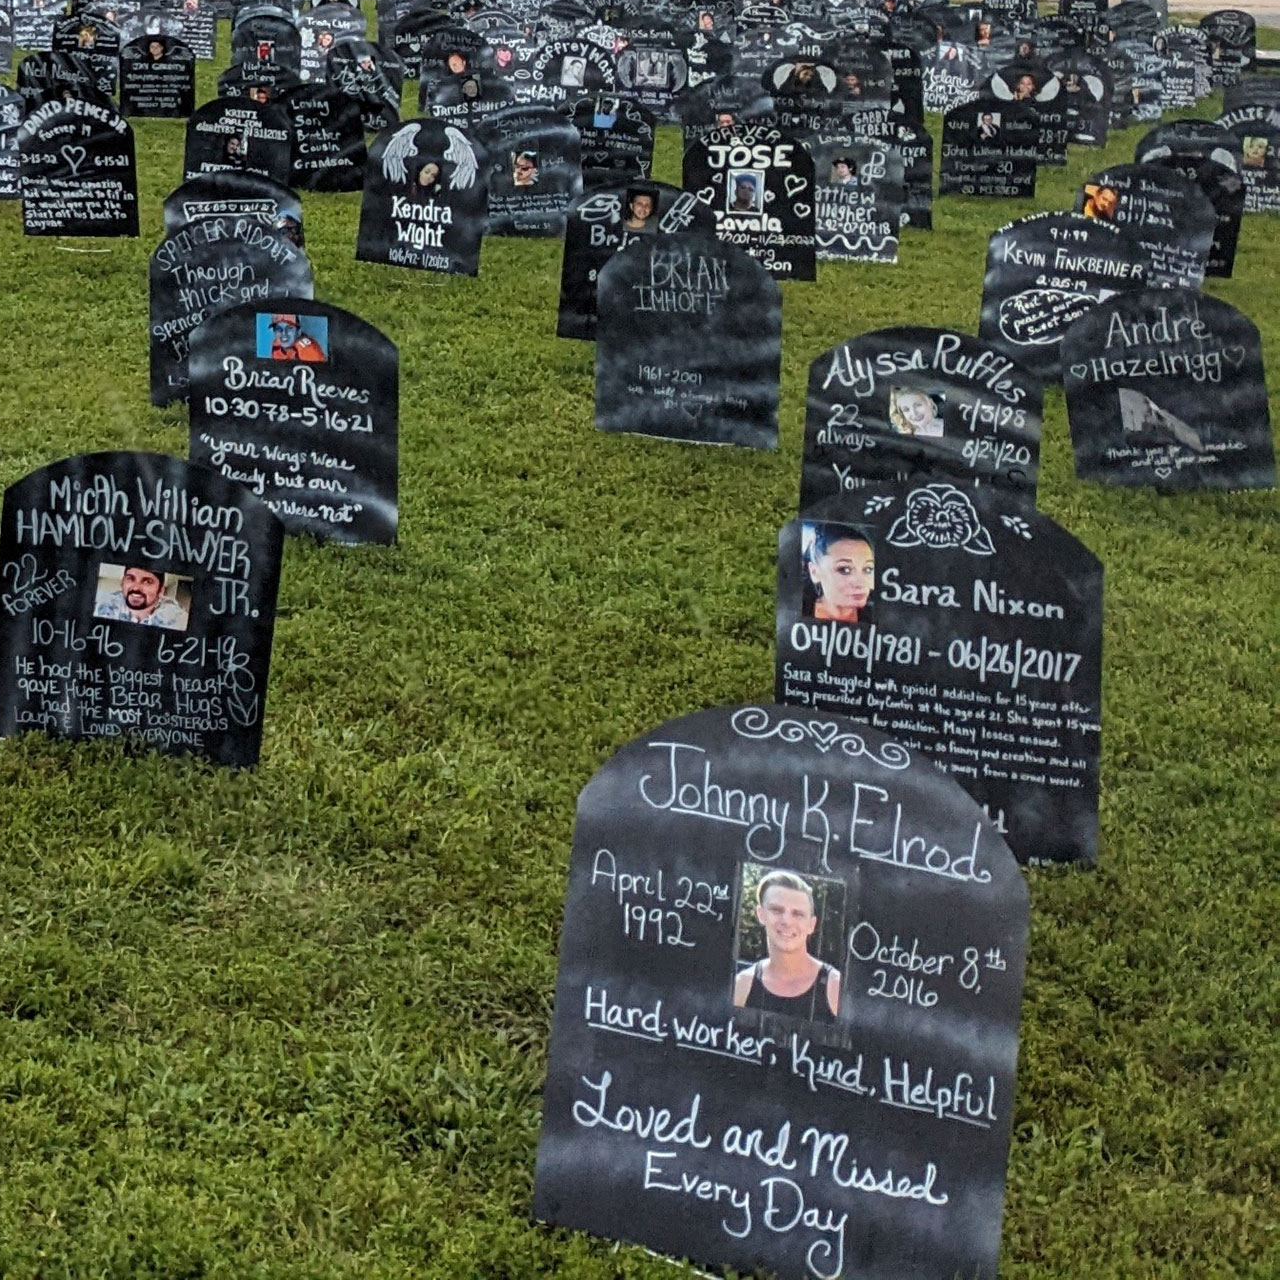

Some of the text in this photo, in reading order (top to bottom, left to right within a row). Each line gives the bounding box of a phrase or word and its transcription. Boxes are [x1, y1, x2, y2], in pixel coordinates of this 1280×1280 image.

[24, 101, 63, 136] DAVID
[65, 98, 106, 124] PENCE
[292, 100, 329, 116] Loving
[294, 115, 321, 127] Son
[294, 158, 354, 169] Grandson
[299, 142, 339, 152] Cousin
[707, 144, 794, 169] JOSE
[391, 197, 452, 224] Kendra
[233, 219, 297, 265] RIDOUT
[1004, 240, 1143, 278] KEVIN FINKBEINER
[764, 259, 792, 271] Son
[223, 356, 370, 408] Brian Reeves
[638, 364, 703, 386] 1961-2001
[822, 334, 1026, 404] Alyssa Ruffles
[1091, 349, 1223, 382] Hazelrigg
[829, 404, 864, 428] 22
[959, 397, 1026, 430] 7/3/98
[817, 427, 876, 450] always
[275, 471, 304, 488] but
[137, 477, 244, 532] William
[2, 553, 48, 594] 22
[209, 576, 259, 617] JR.
[880, 568, 1064, 620] Sara Nixon
[32, 618, 124, 657] 10-16-96
[791, 622, 1081, 686] 04/06/1981 06/26/2017
[40, 656, 71, 678] had
[784, 663, 991, 703] Sara struggled opioid addiction
[944, 722, 976, 741] Many
[640, 741, 991, 884] Johnny K. Elrod
[591, 849, 665, 903] April
[623, 904, 695, 947] 1992
[849, 923, 953, 976] October
[869, 975, 939, 1006] 2016
[881, 1057, 997, 1125] Helpful
[574, 1070, 948, 1205] Loved and Missed
[644, 1150, 848, 1280] Every Day
